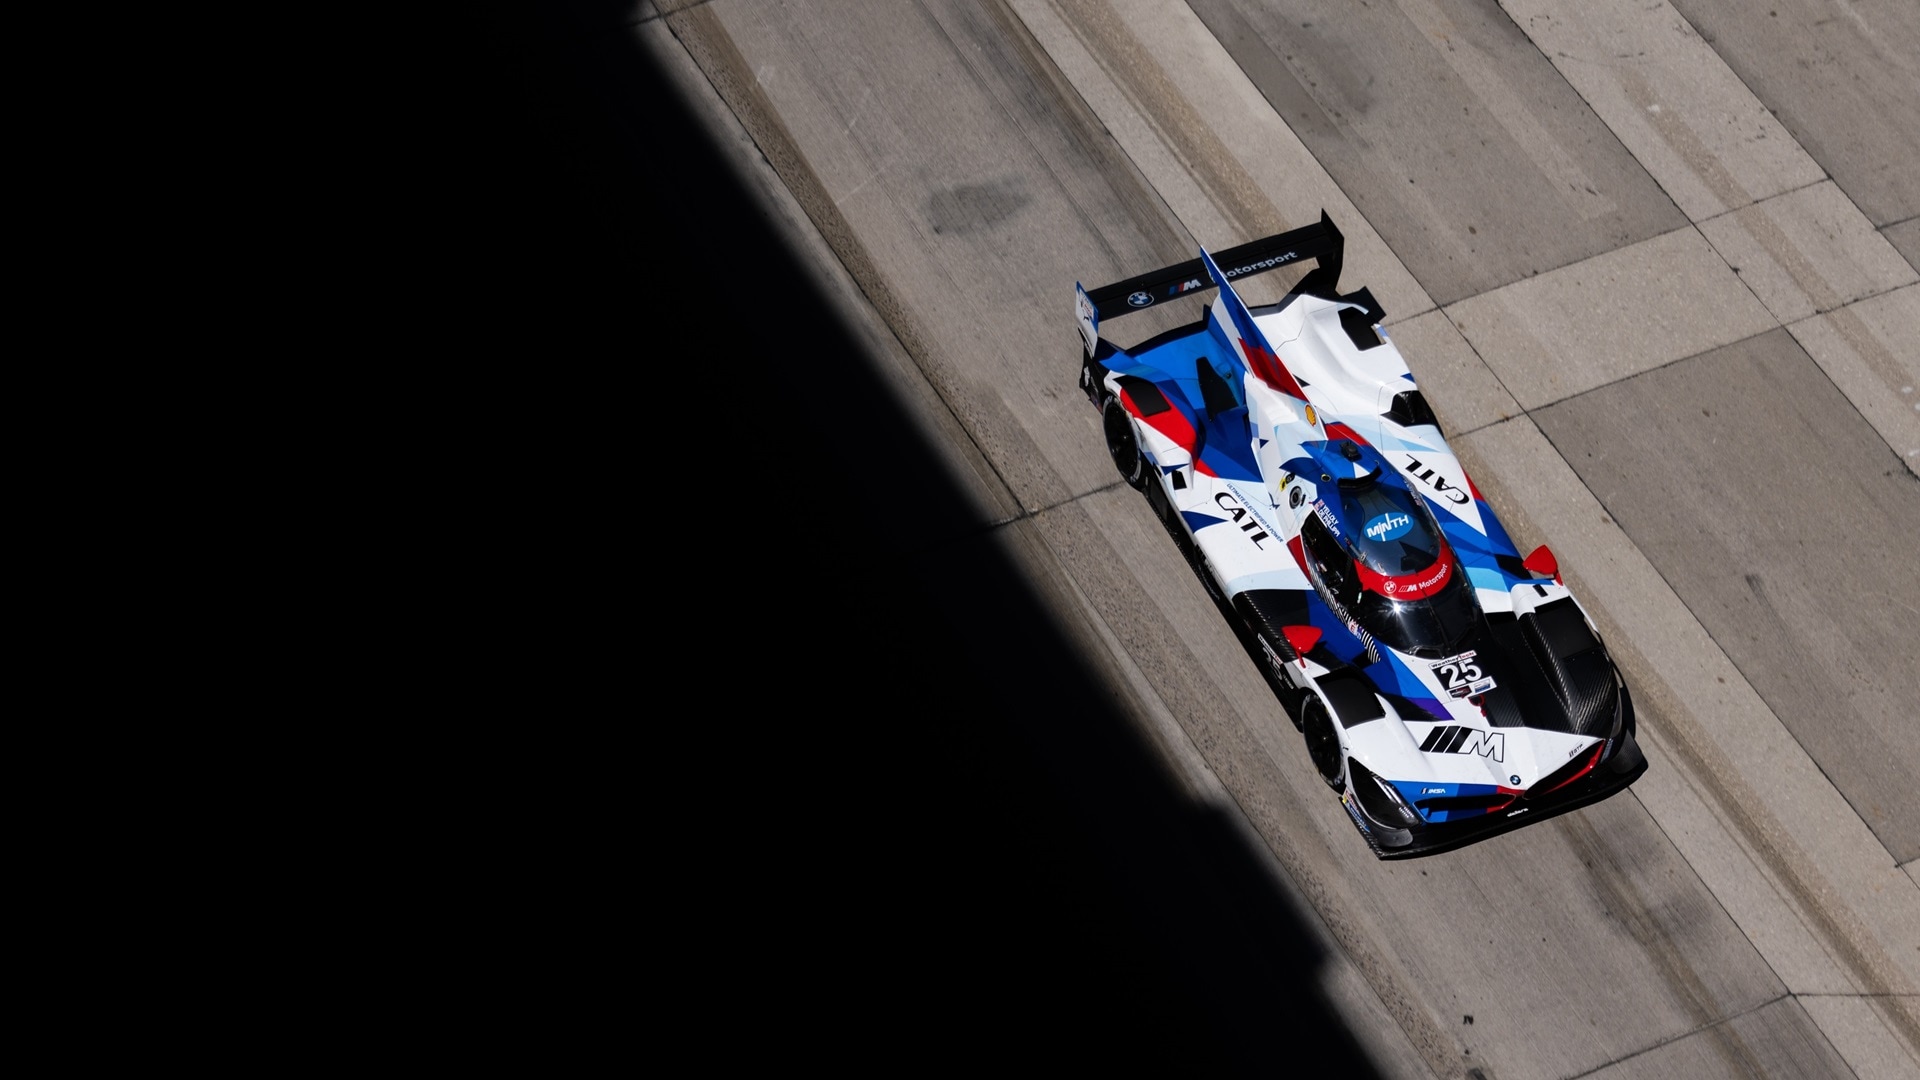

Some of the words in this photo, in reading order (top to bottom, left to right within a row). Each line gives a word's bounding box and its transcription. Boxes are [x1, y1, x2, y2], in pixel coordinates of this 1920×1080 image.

[1221, 251, 1298, 279] otorsport
[1405, 453, 1470, 505] CATL
[1214, 491, 1270, 551] CATL
[1226, 482, 1246, 502] ULTIMATE
[1268, 526, 1285, 543] POWER
[1366, 512, 1410, 542] MINTH
[1418, 563, 1449, 590] Motorsport
[1440, 657, 1483, 689] 25
